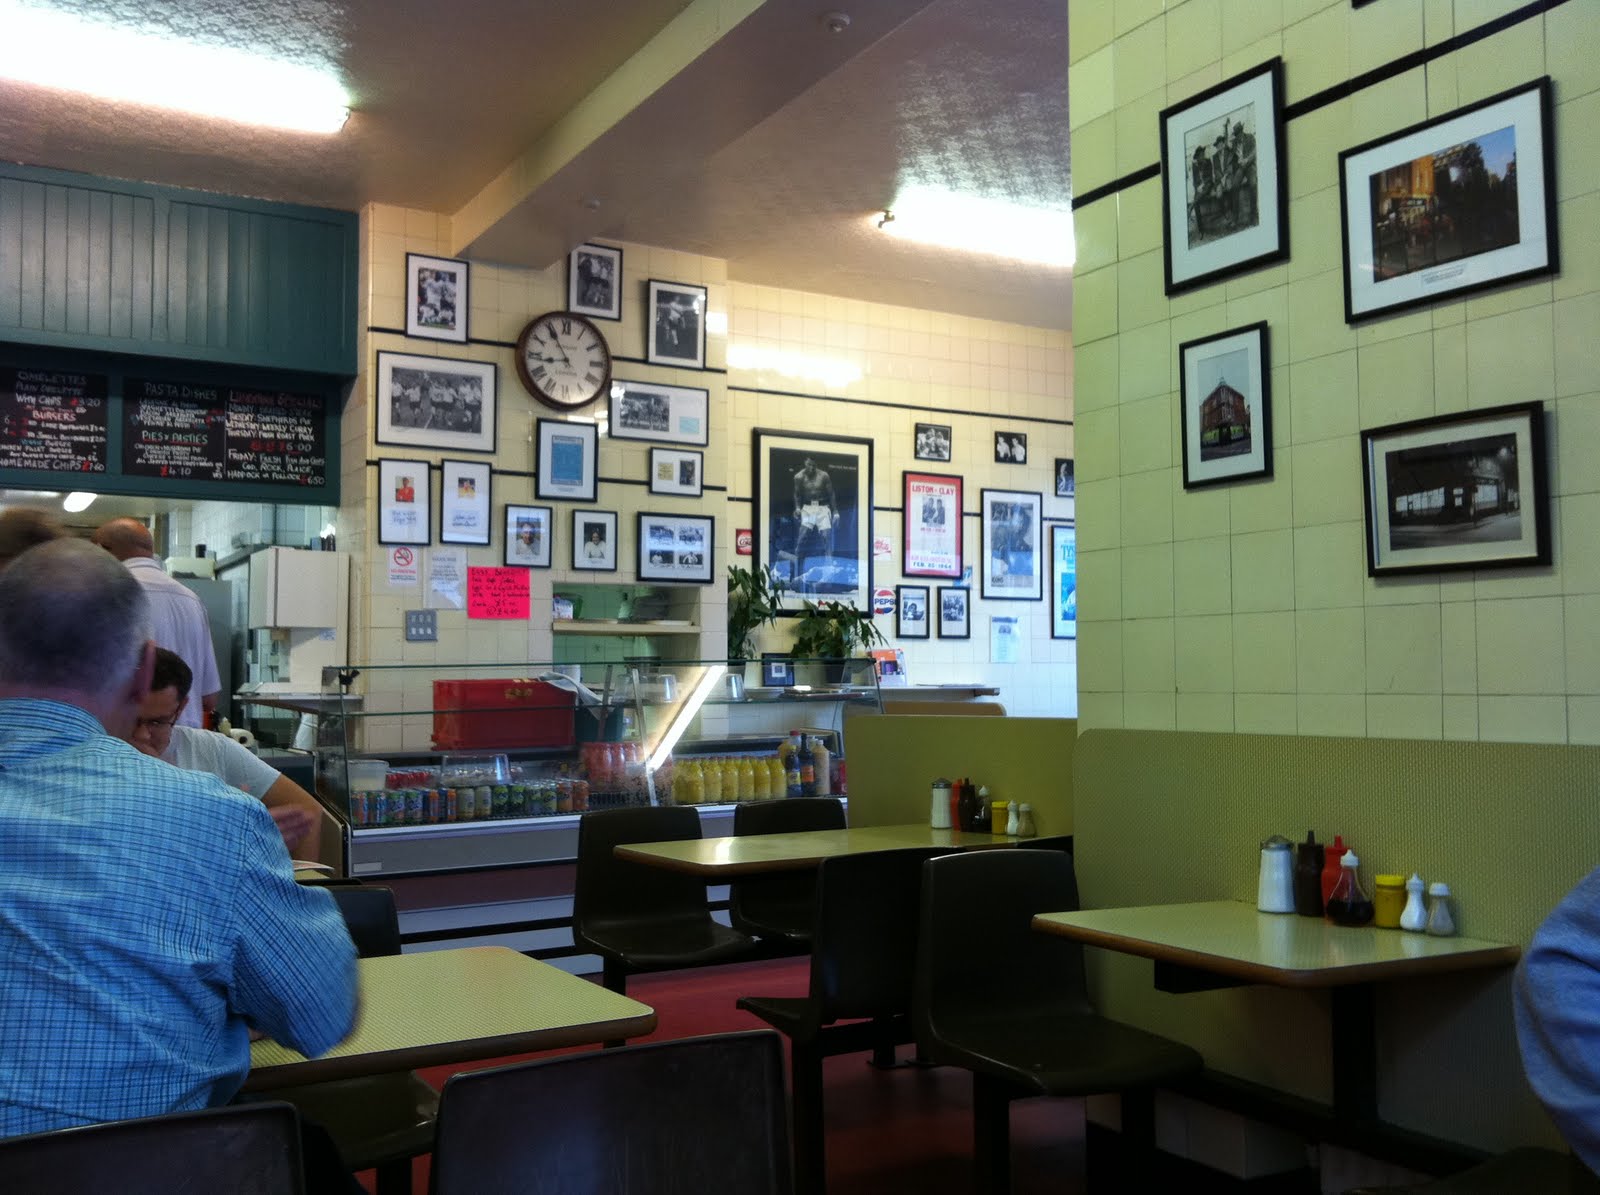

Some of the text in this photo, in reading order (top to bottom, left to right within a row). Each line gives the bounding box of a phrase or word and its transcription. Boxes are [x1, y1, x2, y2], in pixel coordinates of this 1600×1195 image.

[144, 382, 217, 400] PASTA DISHES
[32, 410, 77, 422] BURGERS
[142, 430, 163, 442] PIES
[172, 432, 208, 445] PASTIES
[52, 460, 80, 471] CHIPS
[912, 485, 934, 493] LISTON
[939, 487, 954, 496] CLAY
